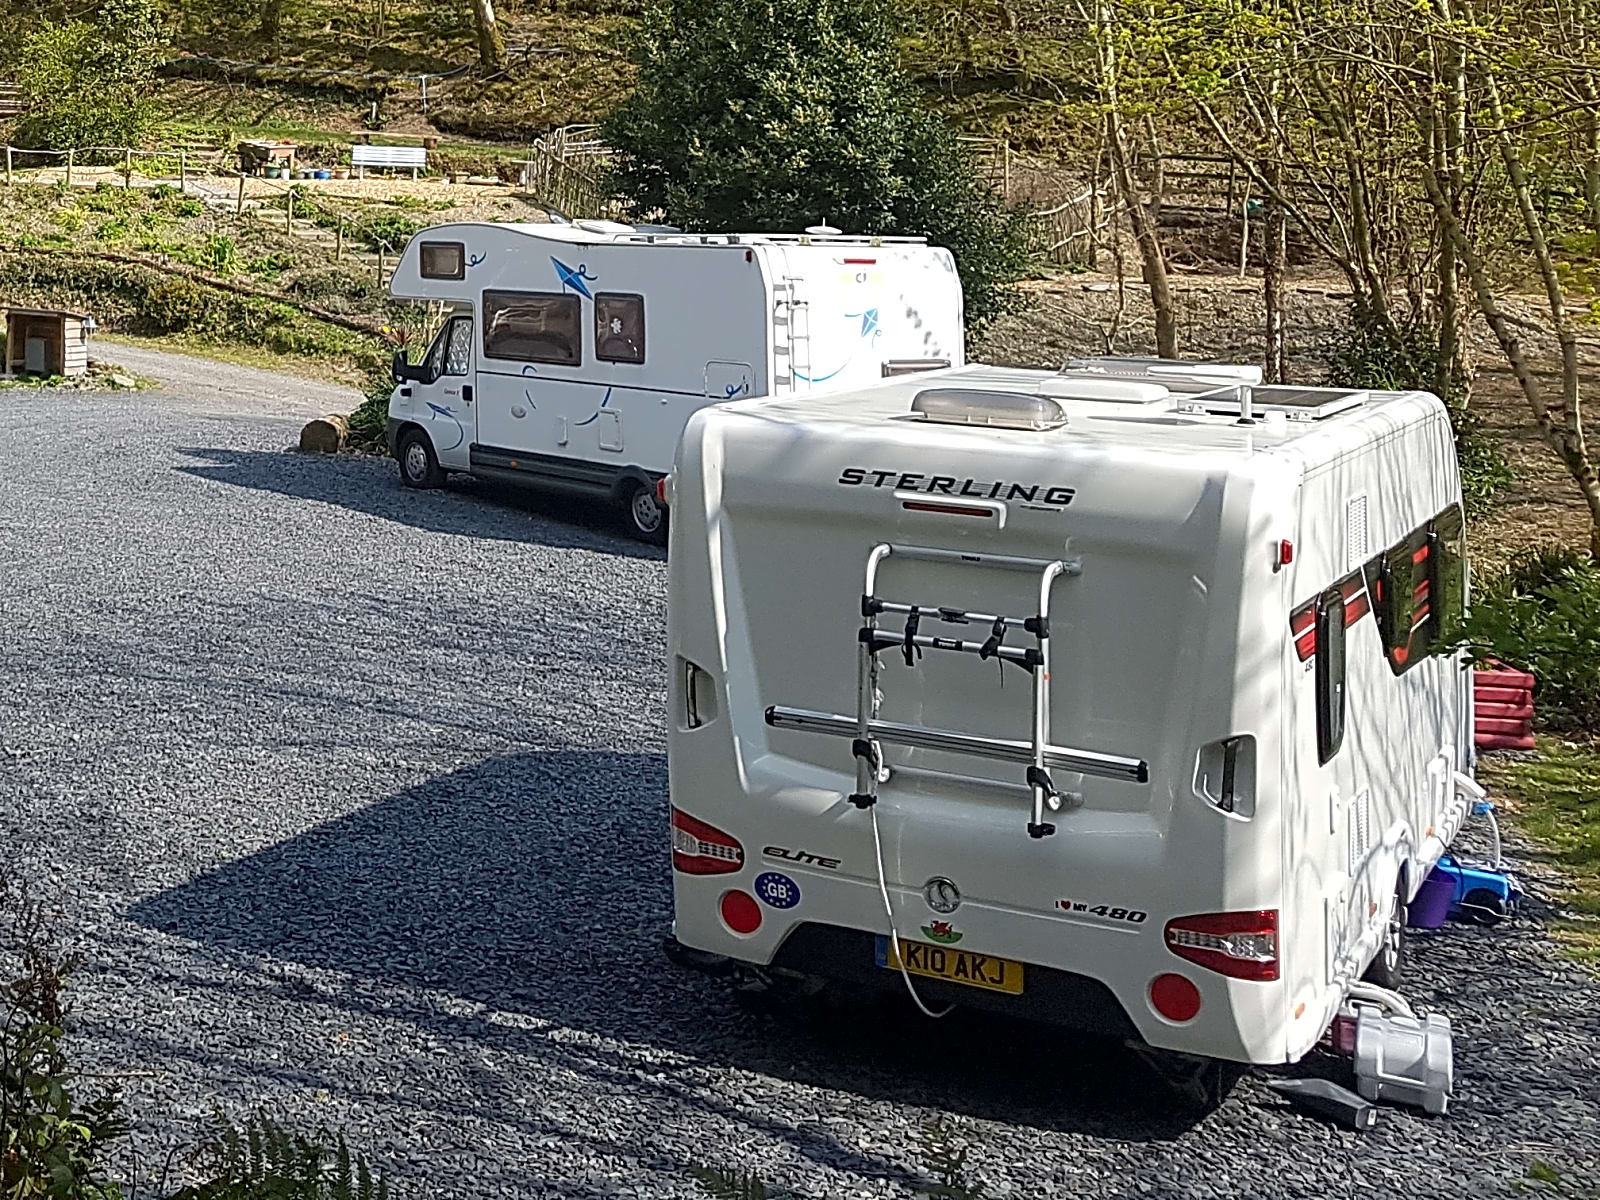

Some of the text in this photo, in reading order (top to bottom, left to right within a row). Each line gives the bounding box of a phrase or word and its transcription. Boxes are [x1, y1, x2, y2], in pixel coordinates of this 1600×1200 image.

[838, 468, 1076, 505] STERLING
[767, 882, 787, 899] GB
[1073, 903, 1088, 912] MY
[1089, 905, 1148, 923] 480
[954, 953, 1005, 984] AKJ
